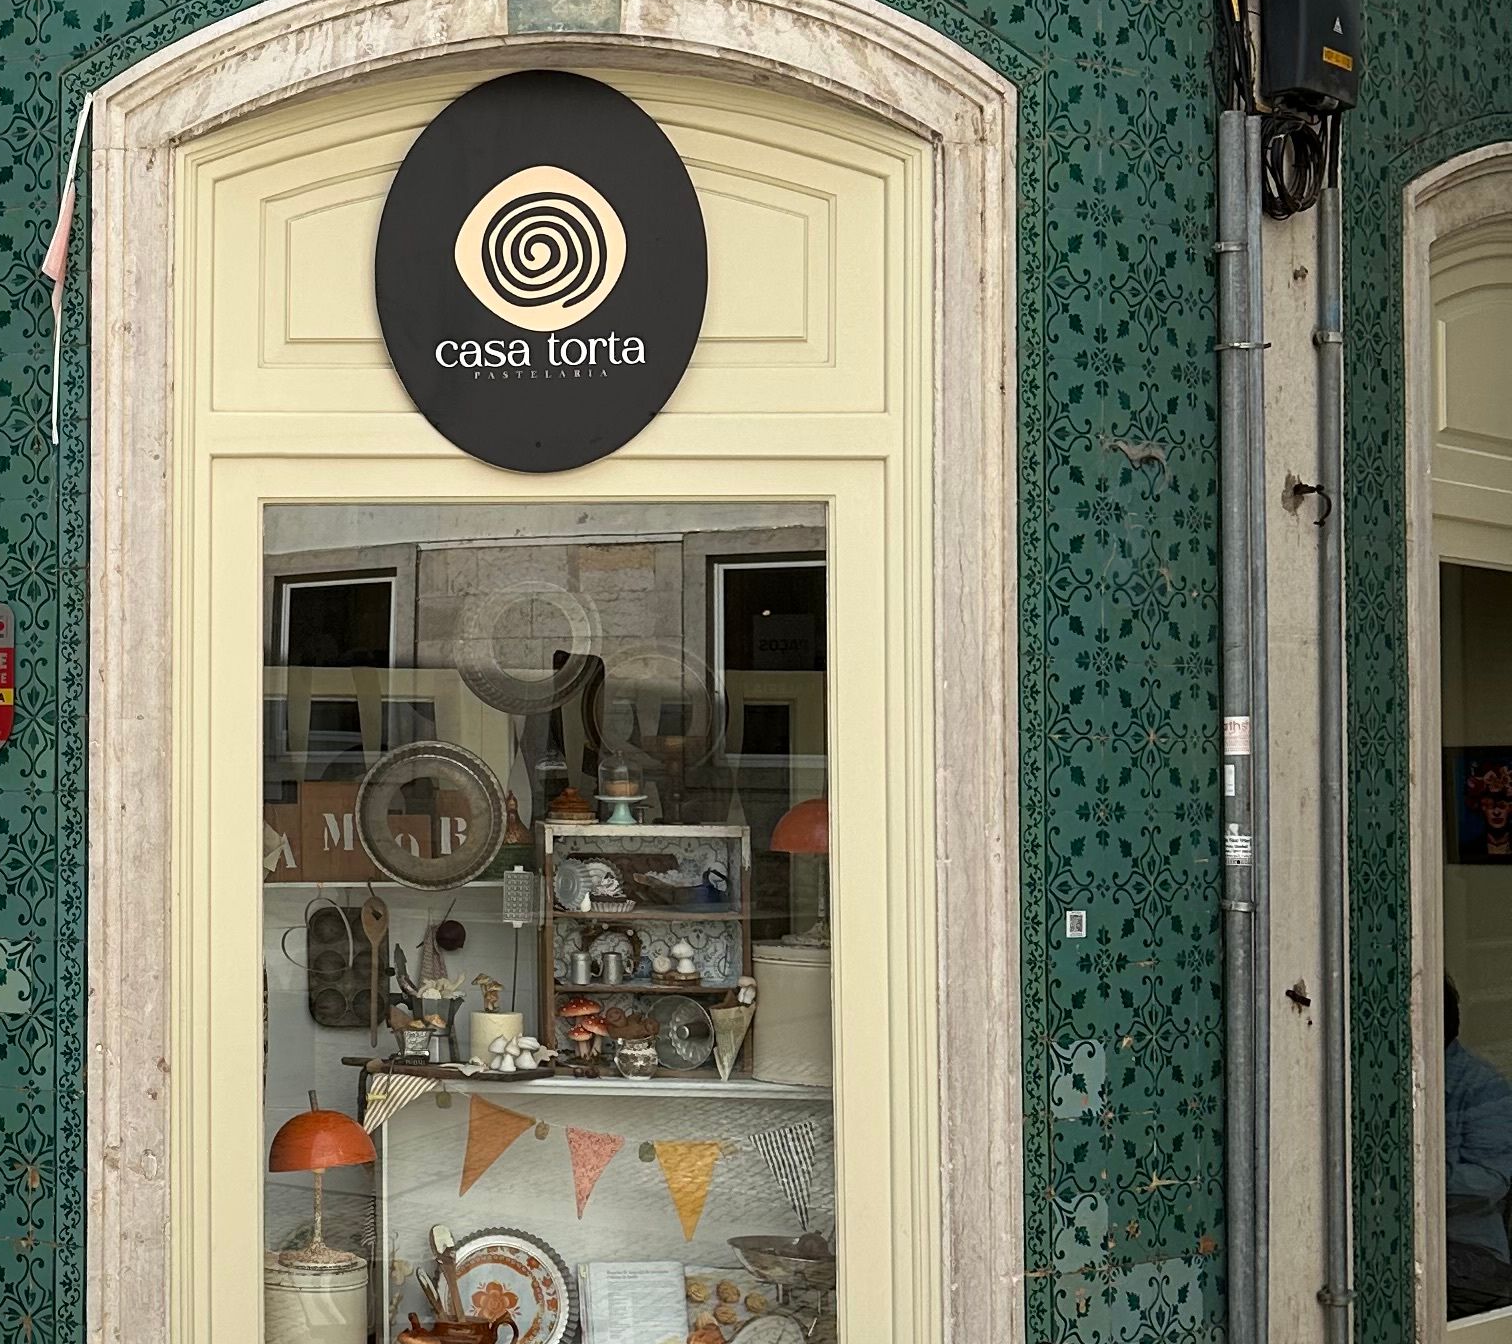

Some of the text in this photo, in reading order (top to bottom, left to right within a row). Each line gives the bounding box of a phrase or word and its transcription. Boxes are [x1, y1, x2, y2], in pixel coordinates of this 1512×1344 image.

[435, 330, 646, 368] casa torta
[474, 369, 609, 380] PASTELARIA
